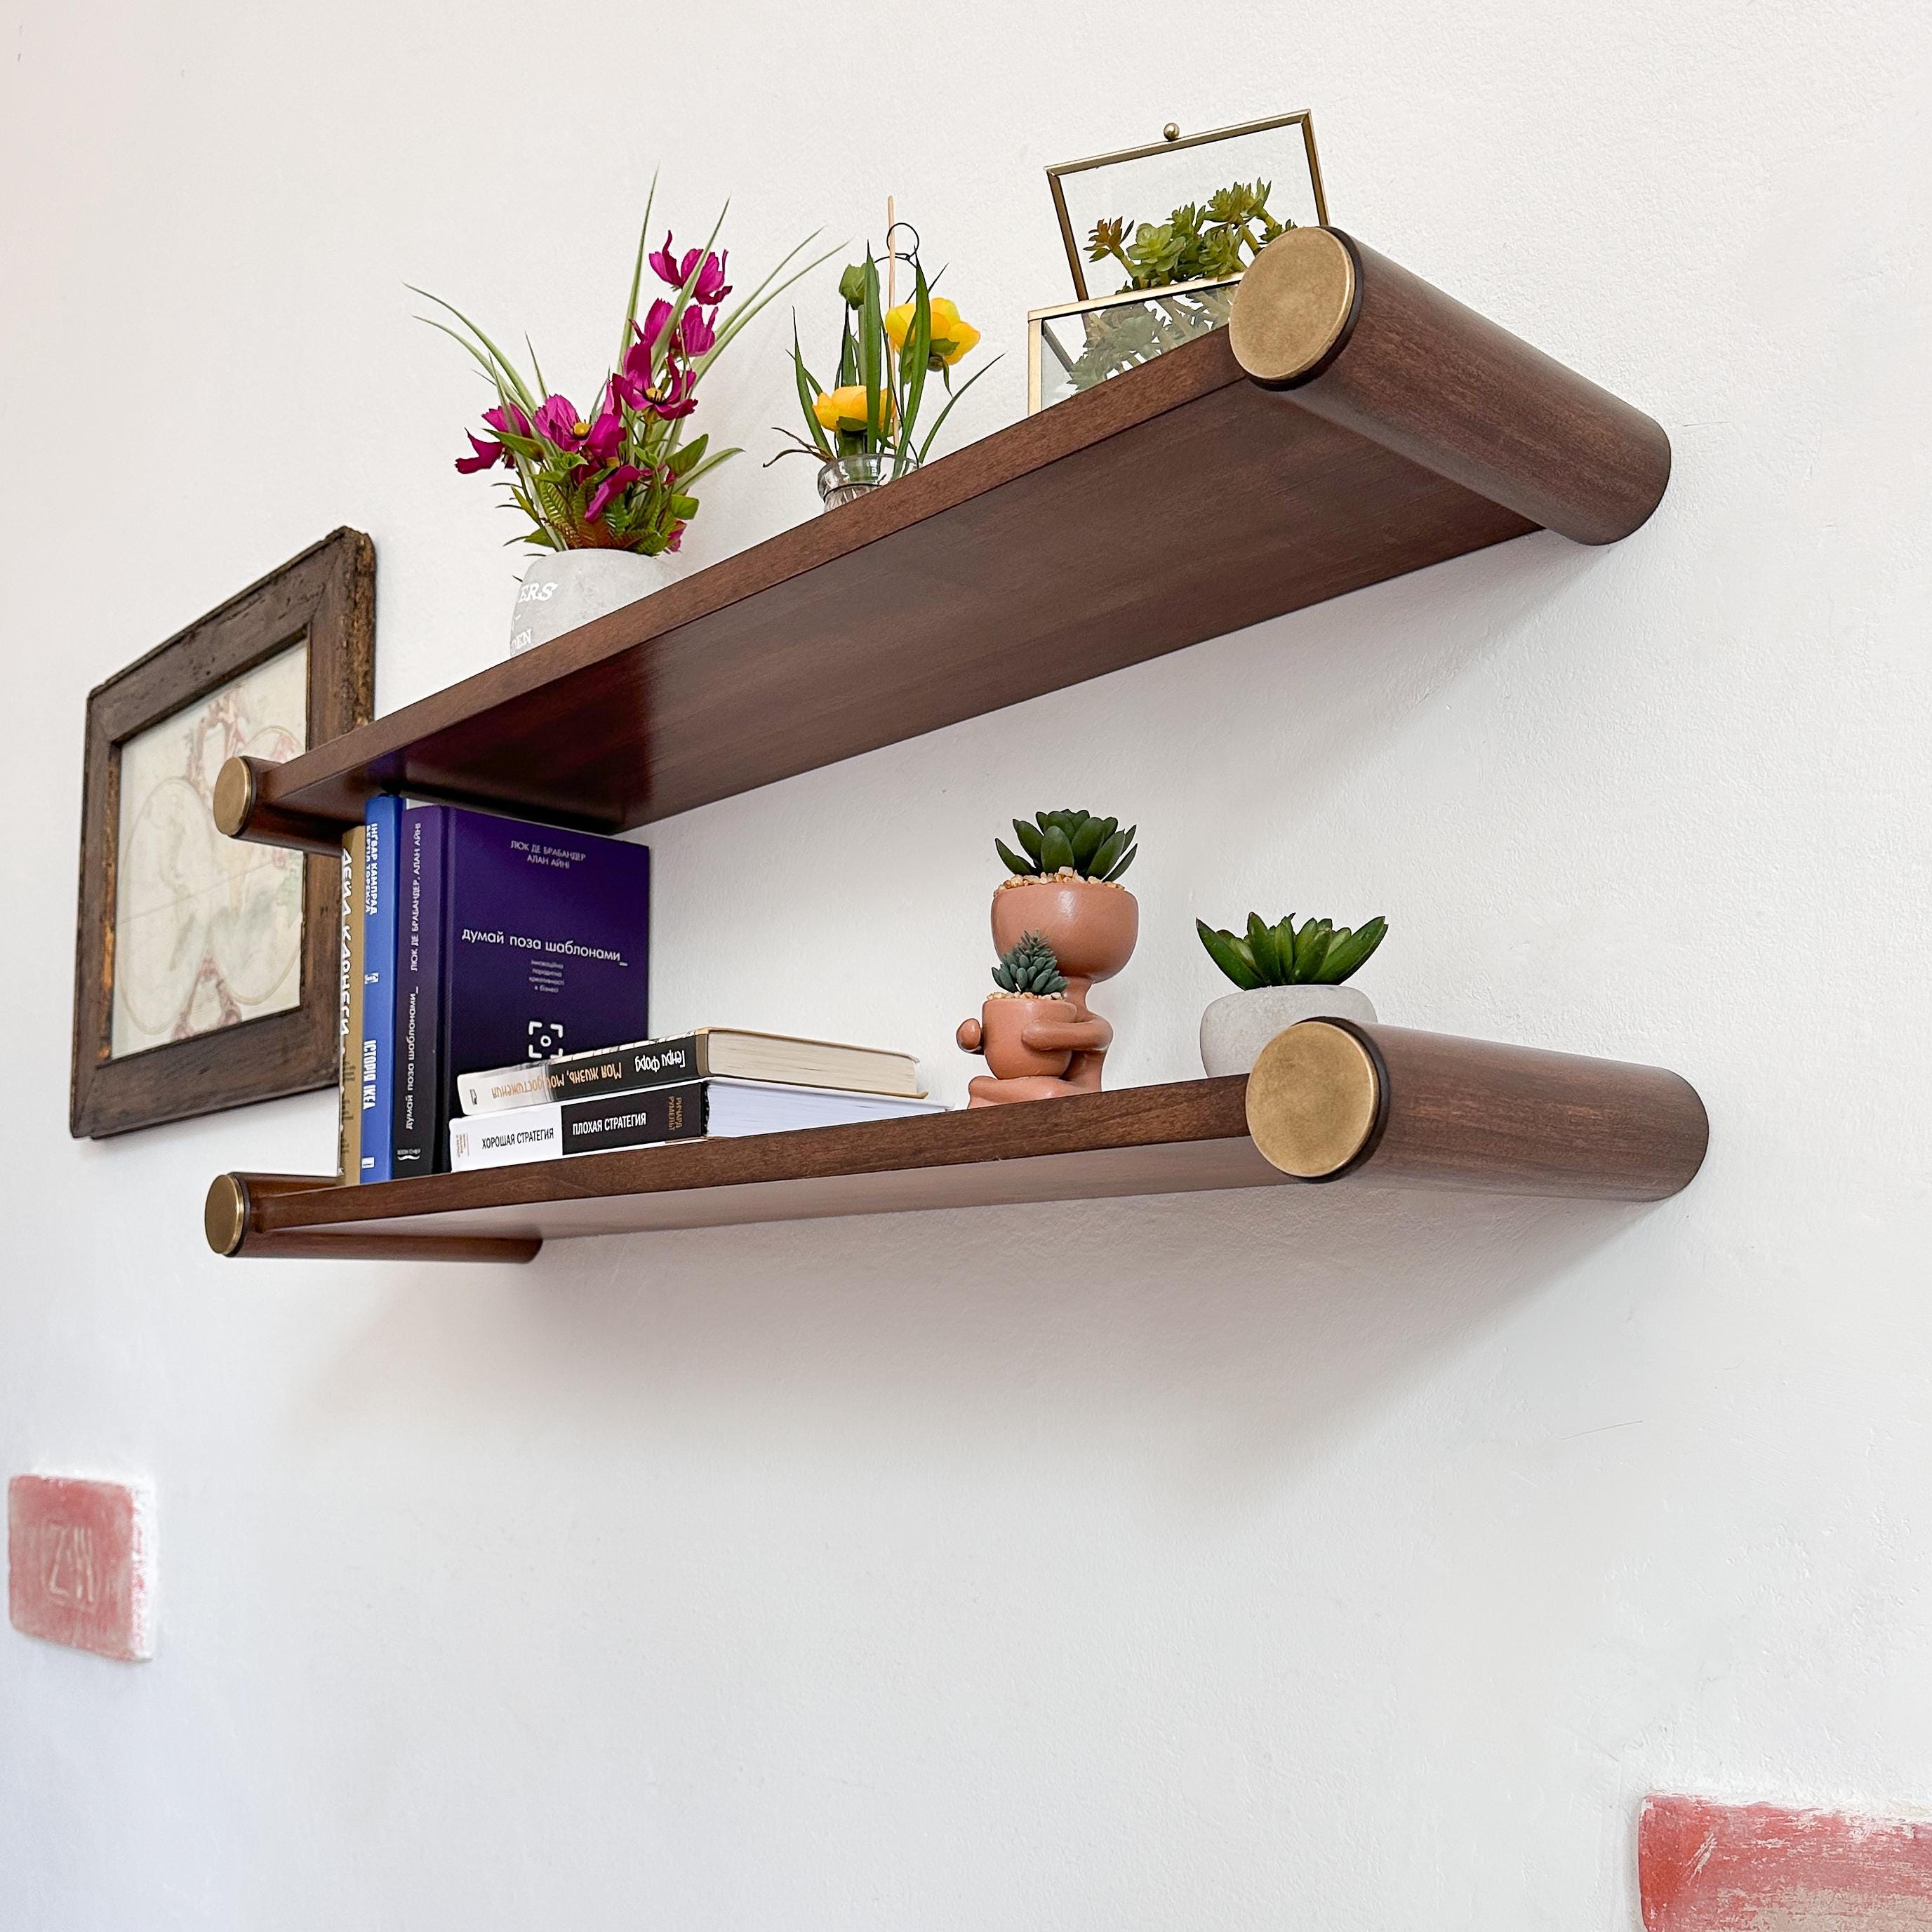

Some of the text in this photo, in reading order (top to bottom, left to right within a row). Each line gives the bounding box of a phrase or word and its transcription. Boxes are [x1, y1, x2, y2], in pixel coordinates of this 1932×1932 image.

[510, 840, 529, 851] ЛЮК
[531, 844, 541, 854] ДЕ
[413, 848, 421, 876] АЛАН
[527, 854, 549, 865] АЛАН
[369, 862, 378, 916] КАМПРАД
[411, 934, 420, 947] ДЕ
[461, 928, 505, 944] думай
[509, 935, 542, 950] поза
[410, 947, 419, 972] ЛЮК
[363, 1040, 377, 1082] ІСТОРІЯ
[601, 1061, 622, 1081] Моя
[634, 1049, 686, 1073] Генри Форд
[406, 1062, 415, 1091] поза
[491, 1075, 542, 1099] достижения
[406, 1093, 414, 1131] думай
[572, 1112, 646, 1136] ПЛОХАЯ СТРАТЕГИЯ
[481, 1133, 516, 1150] ХОРОШАЯ
[517, 1127, 554, 1145] СТРАТЕГИЯ
